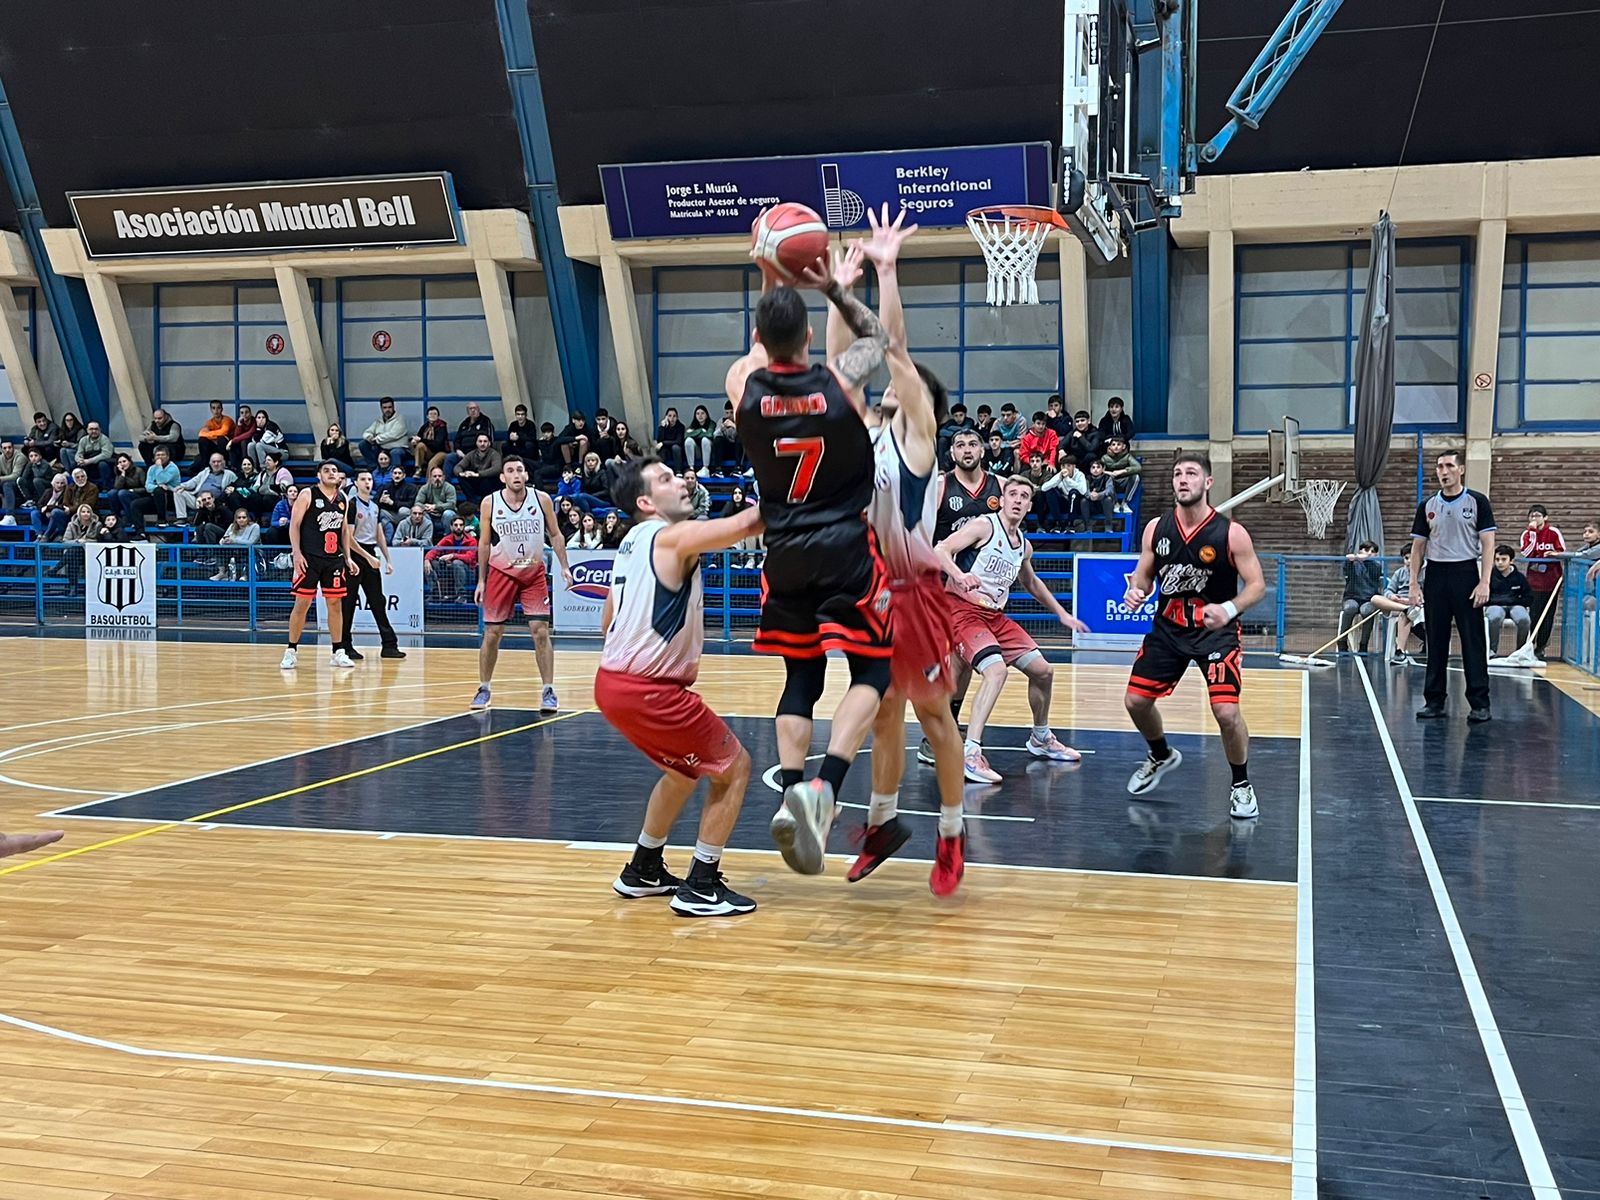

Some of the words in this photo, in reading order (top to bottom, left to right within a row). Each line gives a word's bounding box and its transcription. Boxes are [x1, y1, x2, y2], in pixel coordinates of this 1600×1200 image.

[896, 165, 949, 180] Berkley
[665, 184, 692, 198] Jorge
[693, 183, 704, 195] E.
[705, 181, 739, 194] Murúa
[898, 178, 992, 194] International
[668, 199, 706, 208] Productor
[708, 197, 735, 206] Asesor
[737, 196, 748, 206] de
[749, 196, 780, 207] seguros
[900, 198, 955, 213] Seguros
[113, 203, 260, 239] Asociación
[258, 198, 357, 232] Mutual
[356, 195, 416, 228] Bell
[670, 209, 704, 218] Matrícula
[716, 208, 739, 217] 49148
[773, 437, 825, 503] 7
[496, 520, 541, 537] BOCHAS
[324, 531, 338, 554] 8
[517, 543, 526, 557] 4
[333, 577, 341, 588] 8
[90, 614, 152, 626] BASQUETBOL
[1207, 662, 1226, 684] 41
